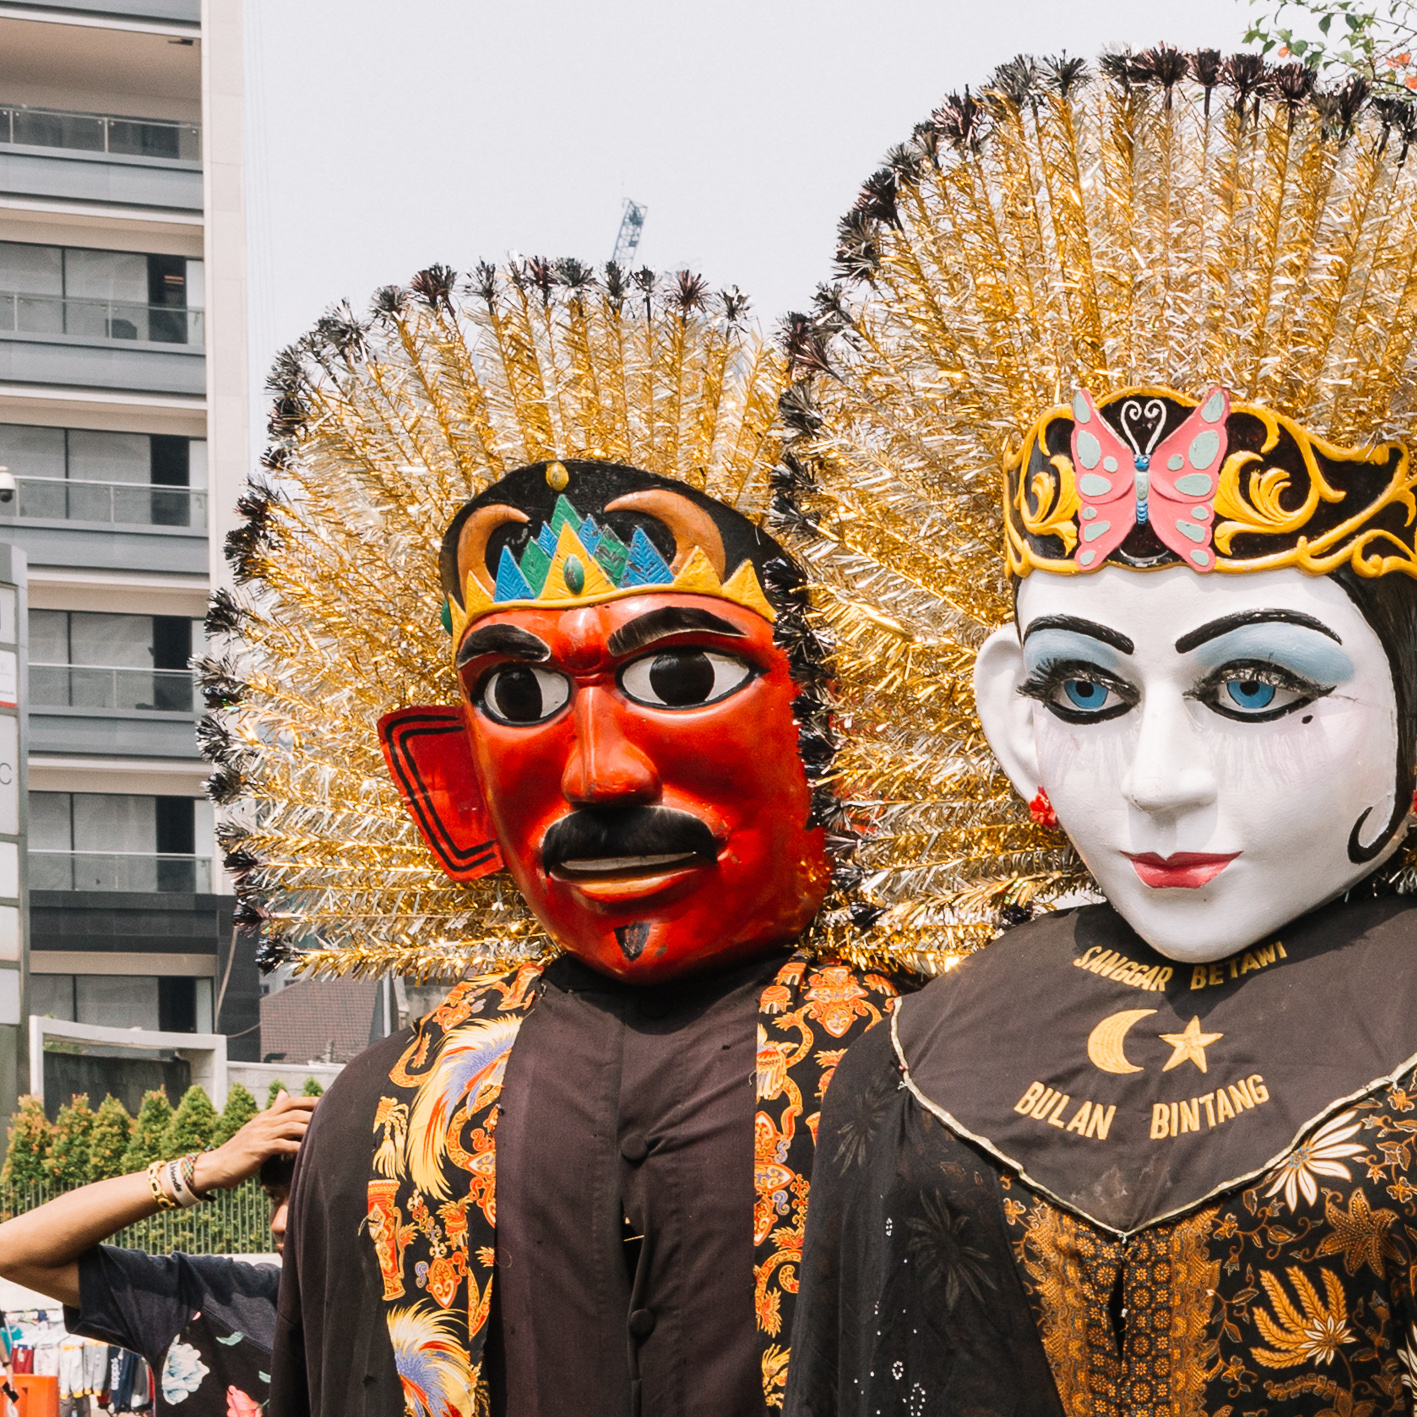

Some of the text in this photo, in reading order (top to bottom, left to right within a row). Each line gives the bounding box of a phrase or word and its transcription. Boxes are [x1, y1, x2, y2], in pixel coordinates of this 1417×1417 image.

[1073, 941, 1287, 991] SANGGAR BETAWI
[1013, 1074, 1270, 1140] BULAN BINTANG
